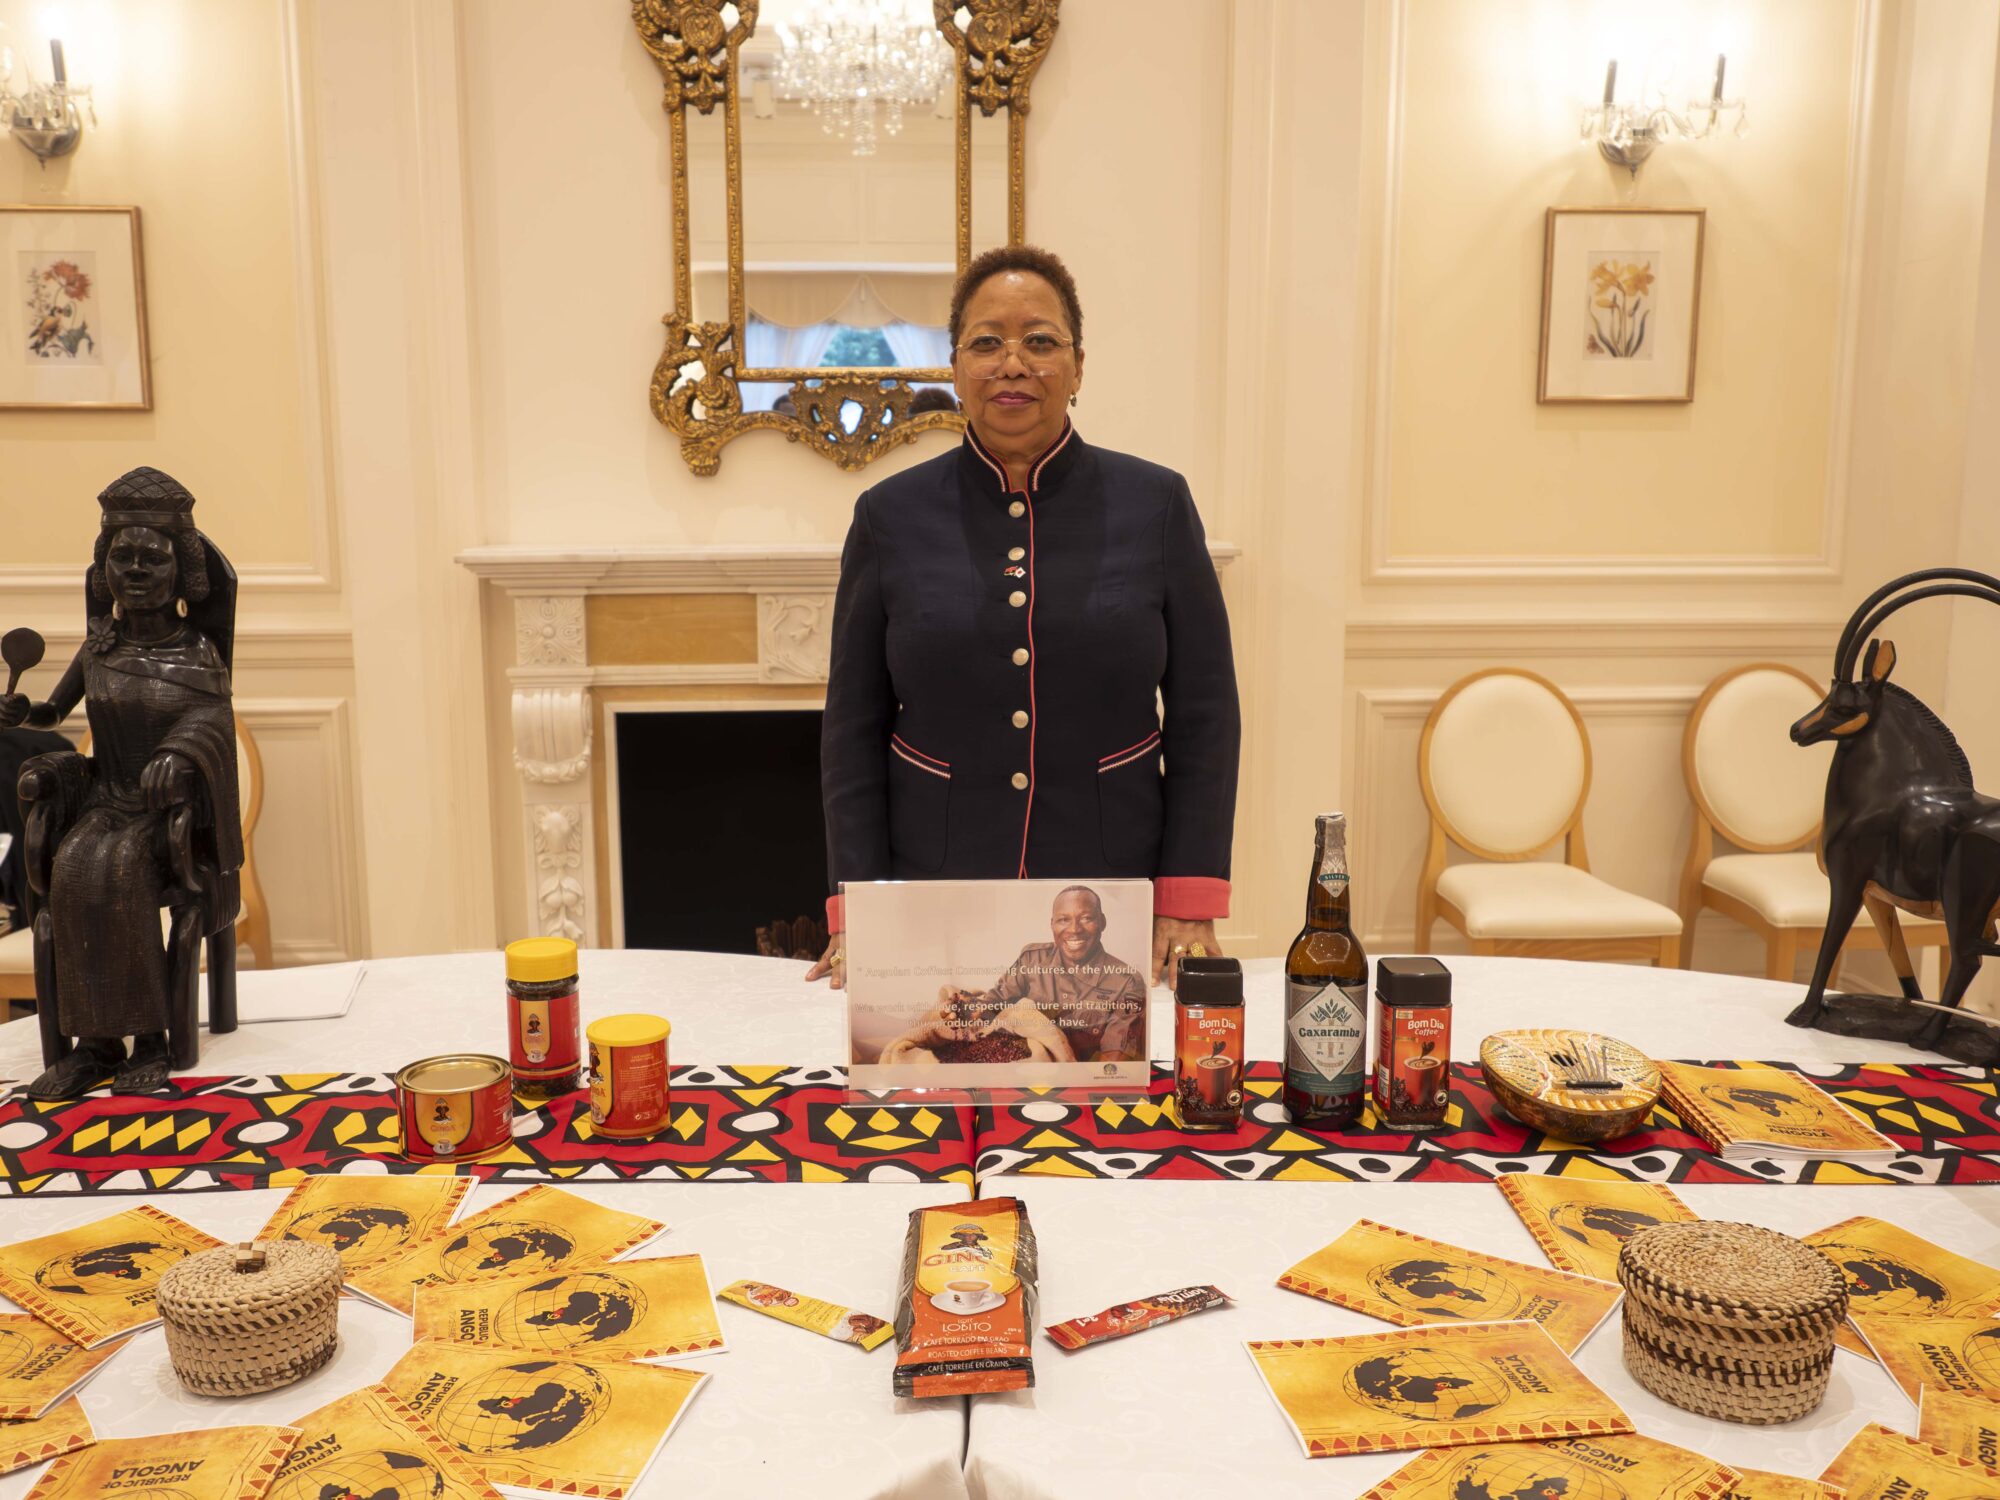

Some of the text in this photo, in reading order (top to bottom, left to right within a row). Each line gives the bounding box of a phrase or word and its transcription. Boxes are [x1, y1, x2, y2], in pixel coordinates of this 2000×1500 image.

[1020, 965, 1066, 975] Cultures
[1068, 965, 1080, 975] of
[1082, 965, 1101, 975] the
[1103, 965, 1138, 975] World
[1062, 1000, 1083, 1010] and
[1086, 1000, 1142, 1011] traditions,
[1059, 1018, 1089, 1027] have.
[1199, 1018, 1237, 1030] Bom Dia
[1298, 1027, 1360, 1037] Caxaramba
[1408, 1018, 1445, 1030] Bom Dia
[1415, 1028, 1439, 1036] Coffee
[1769, 1127, 1834, 1138] ANGOLA
[1532, 1294, 1545, 1303] OF
[1533, 1299, 1562, 1323] GOLA
[460, 1309, 476, 1341] ANGO
[478, 1308, 489, 1341] REPUBLIC
[942, 1322, 992, 1332] LOBITO
[944, 1335, 976, 1345] TORRADO
[21, 1345, 78, 1381] ANGOLA
[927, 1346, 1008, 1358] ROASTED COFFEE BEANS
[7, 1353, 48, 1379] REPUBLIC
[975, 1361, 985, 1369] EN
[985, 1360, 1010, 1368] GRAINS
[1490, 1355, 1533, 1394] REPUBLIC OF
[1505, 1354, 1554, 1394] ANGOLA
[1918, 1342, 1967, 1391] ANGOLA
[1938, 1345, 1984, 1393] REPUBLIC OF
[408, 1372, 446, 1410] ANGO
[421, 1376, 459, 1415] REPUBLIC
[1566, 1439, 1640, 1468] ANGOL
[1978, 1426, 1998, 1470] ANGO
[112, 1459, 205, 1480] ANGOLA
[275, 1443, 342, 1479] REPUBLIC
[1559, 1448, 1627, 1474] REPUBLIC
[100, 1473, 192, 1490] REPUBLIC OF
